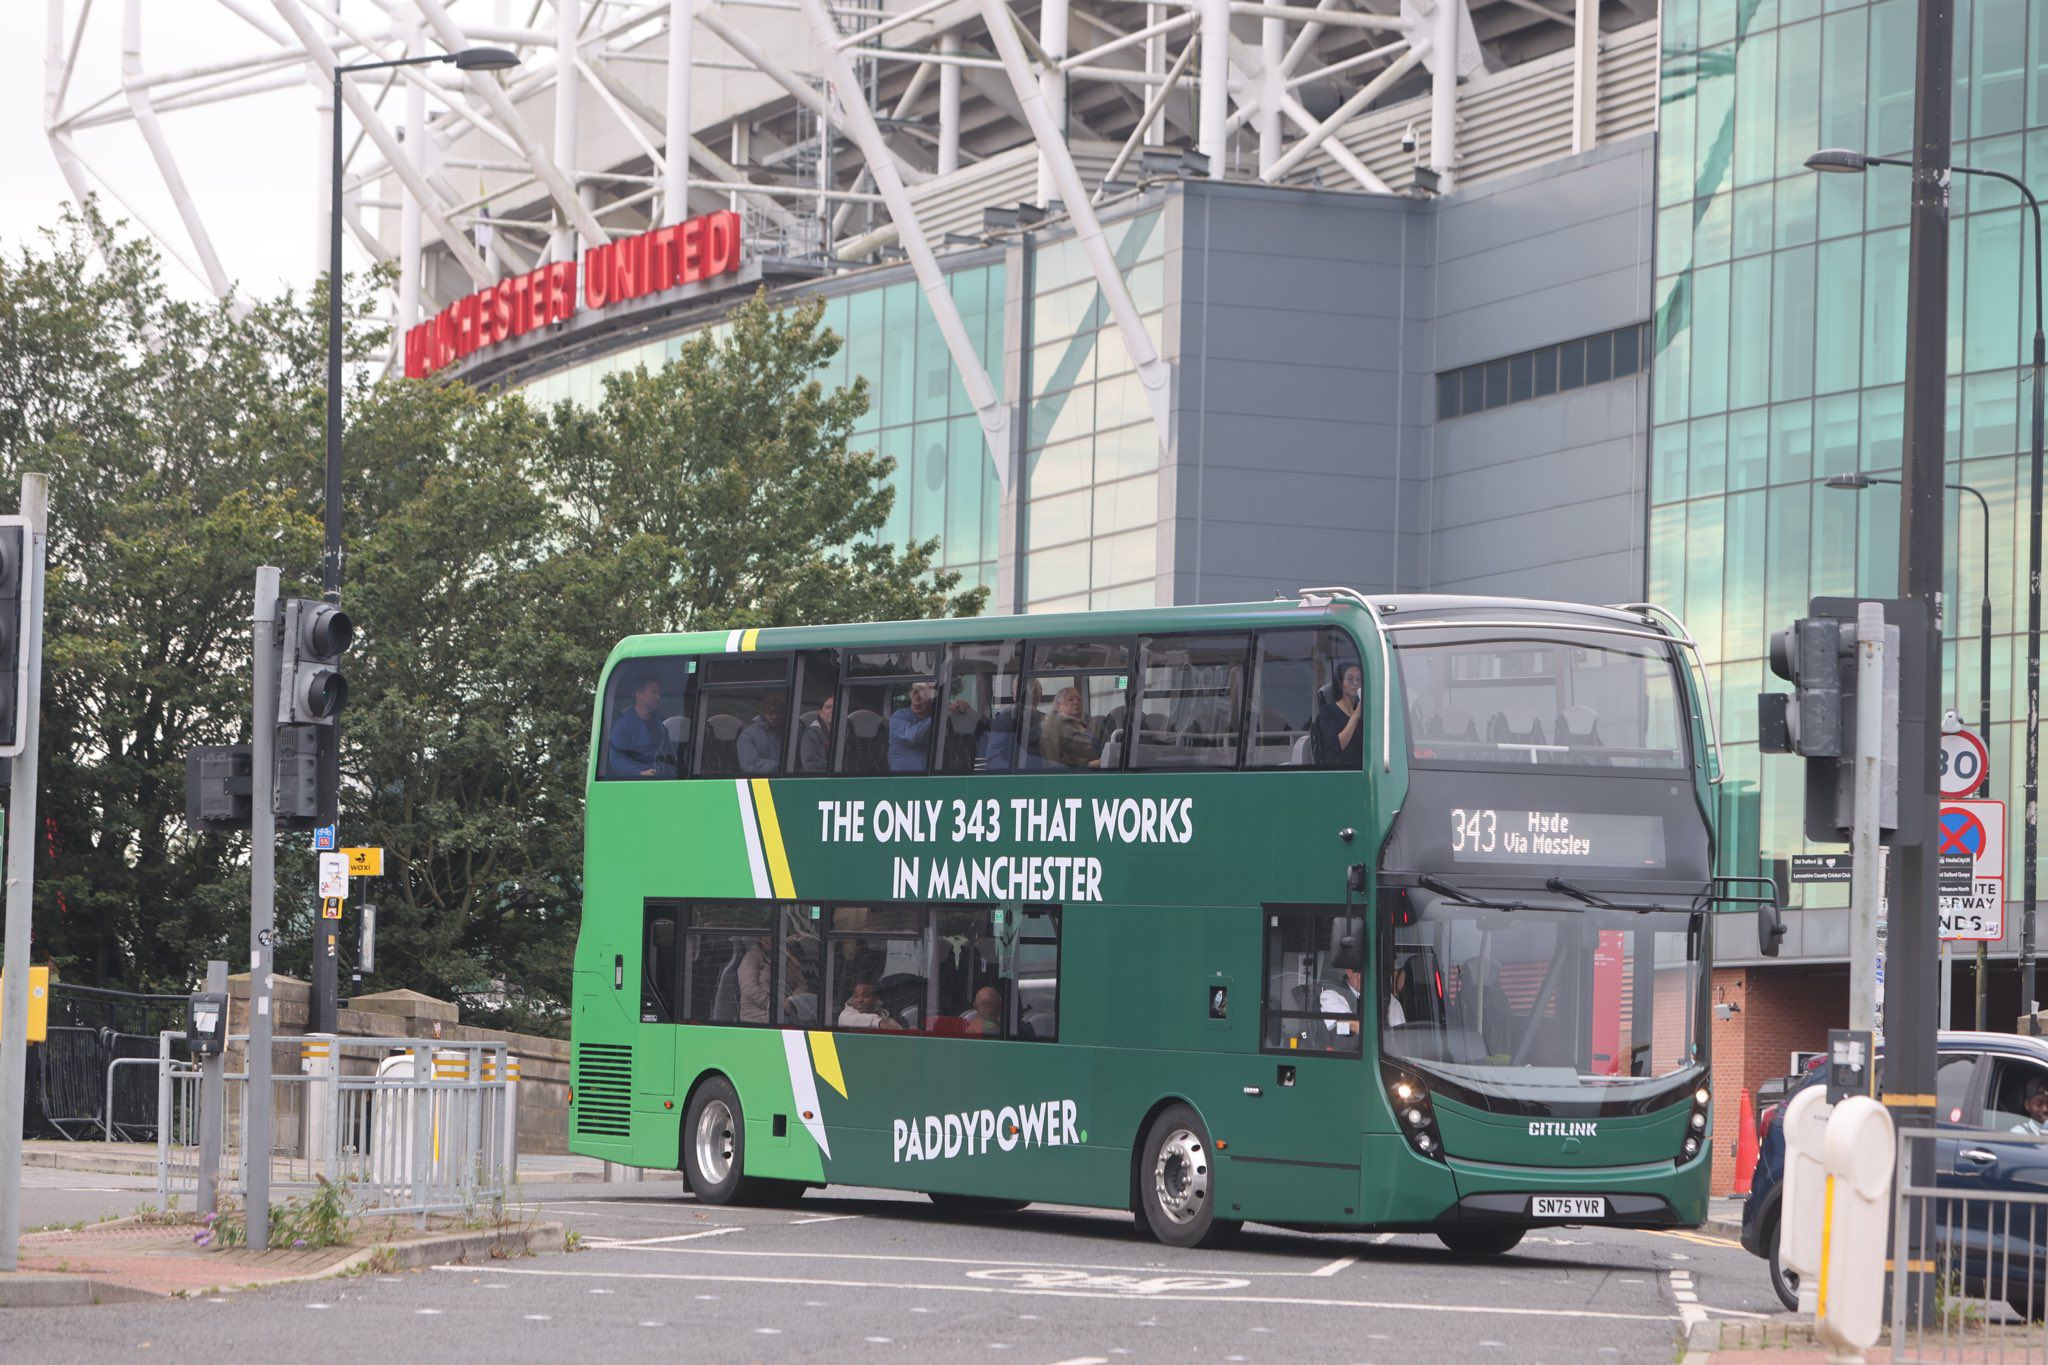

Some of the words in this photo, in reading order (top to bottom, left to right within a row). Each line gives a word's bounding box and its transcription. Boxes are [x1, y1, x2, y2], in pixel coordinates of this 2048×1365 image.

[584, 210, 741, 309] UNITED
[819, 800, 864, 842] THE
[873, 799, 943, 842] ONLY
[951, 799, 1000, 842] 343
[1010, 798, 1082, 842] THAT
[1092, 798, 1193, 843] WORKS
[1451, 809, 1497, 852] 343
[1528, 811, 1569, 833] Hyde
[1503, 832, 1527, 853] Via
[1532, 834, 1590, 855] Mossley
[893, 857, 919, 898] IN
[928, 856, 1103, 901] MANCHESTER
[1528, 1122, 1598, 1137] CITILINK
[1538, 1199, 1572, 1213] SN75
[1575, 1200, 1599, 1214] YVR
